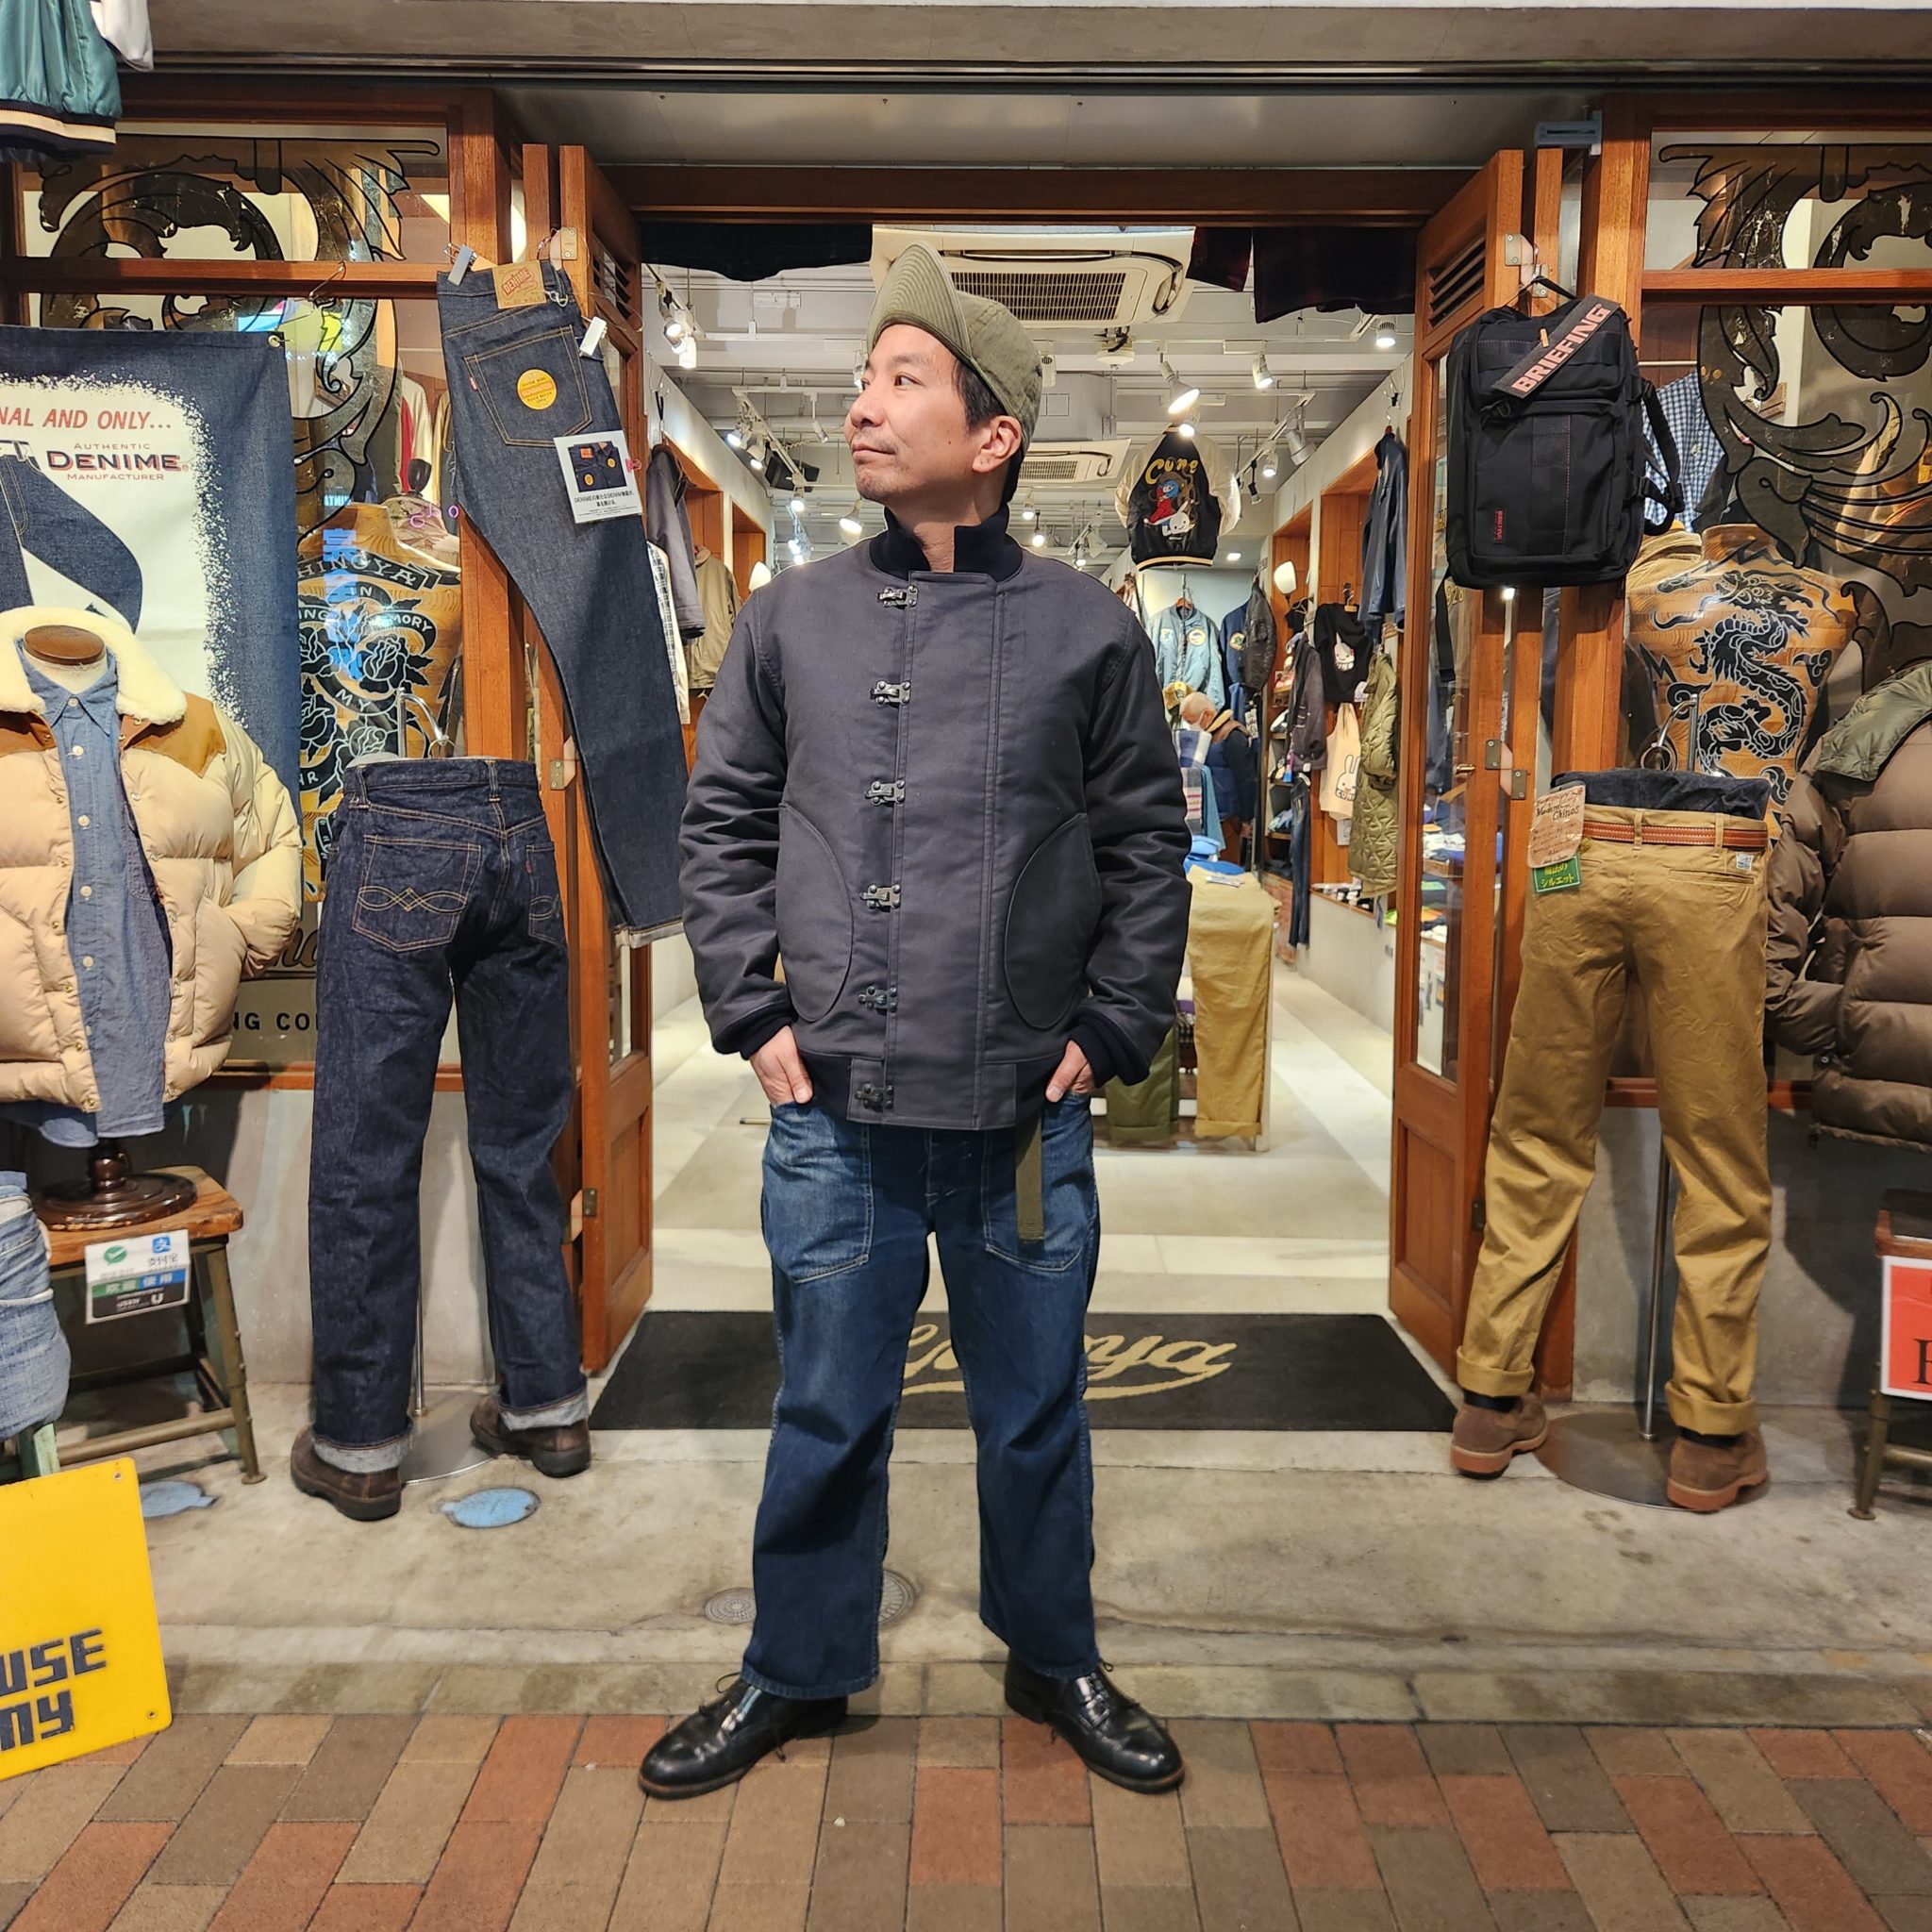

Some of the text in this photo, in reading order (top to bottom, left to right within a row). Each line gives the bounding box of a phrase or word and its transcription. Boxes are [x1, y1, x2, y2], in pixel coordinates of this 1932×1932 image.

[1511, 307, 1611, 393] BRIEFING
[42, 408, 89, 429] AND
[97, 410, 172, 430] ONLY...
[336, 689, 372, 712] MY
[1541, 873, 1574, 888] シルエット
